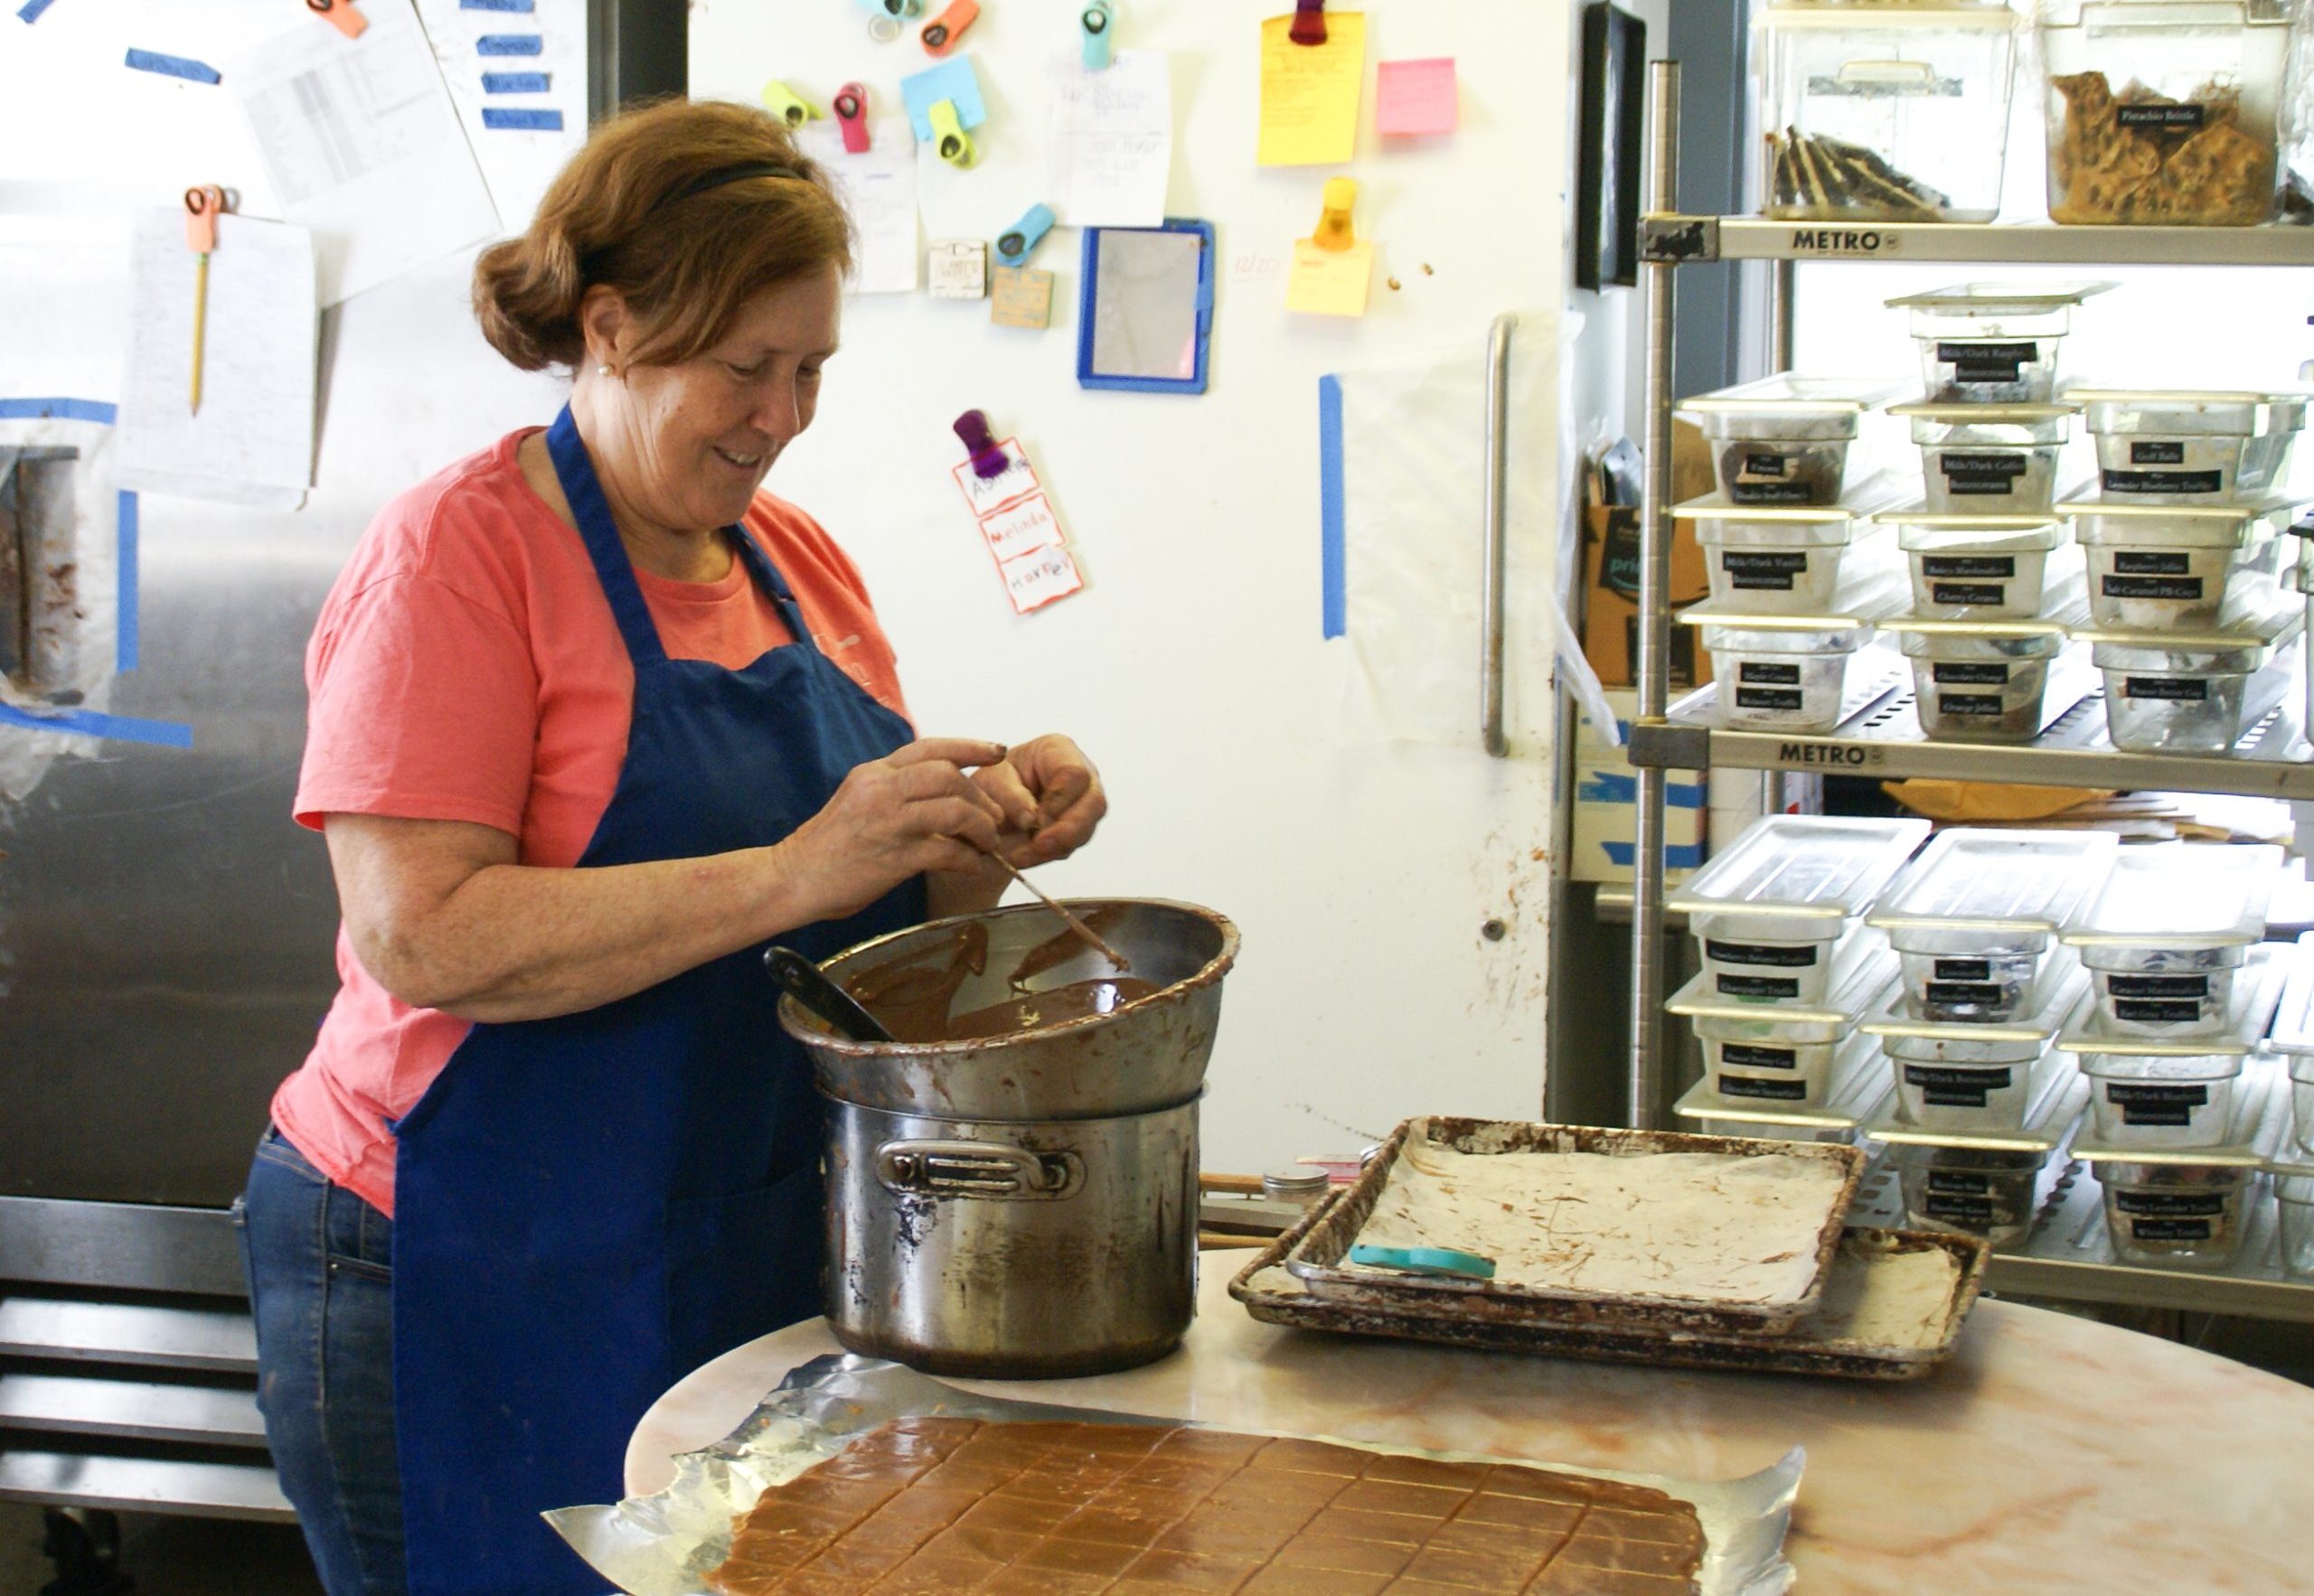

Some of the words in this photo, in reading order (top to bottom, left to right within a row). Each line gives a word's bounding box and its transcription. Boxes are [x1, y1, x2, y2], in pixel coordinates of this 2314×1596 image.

[1792, 230, 1881, 250] METRO
[991, 512, 1049, 544] Melinda
[1779, 743, 1866, 765] METRO
